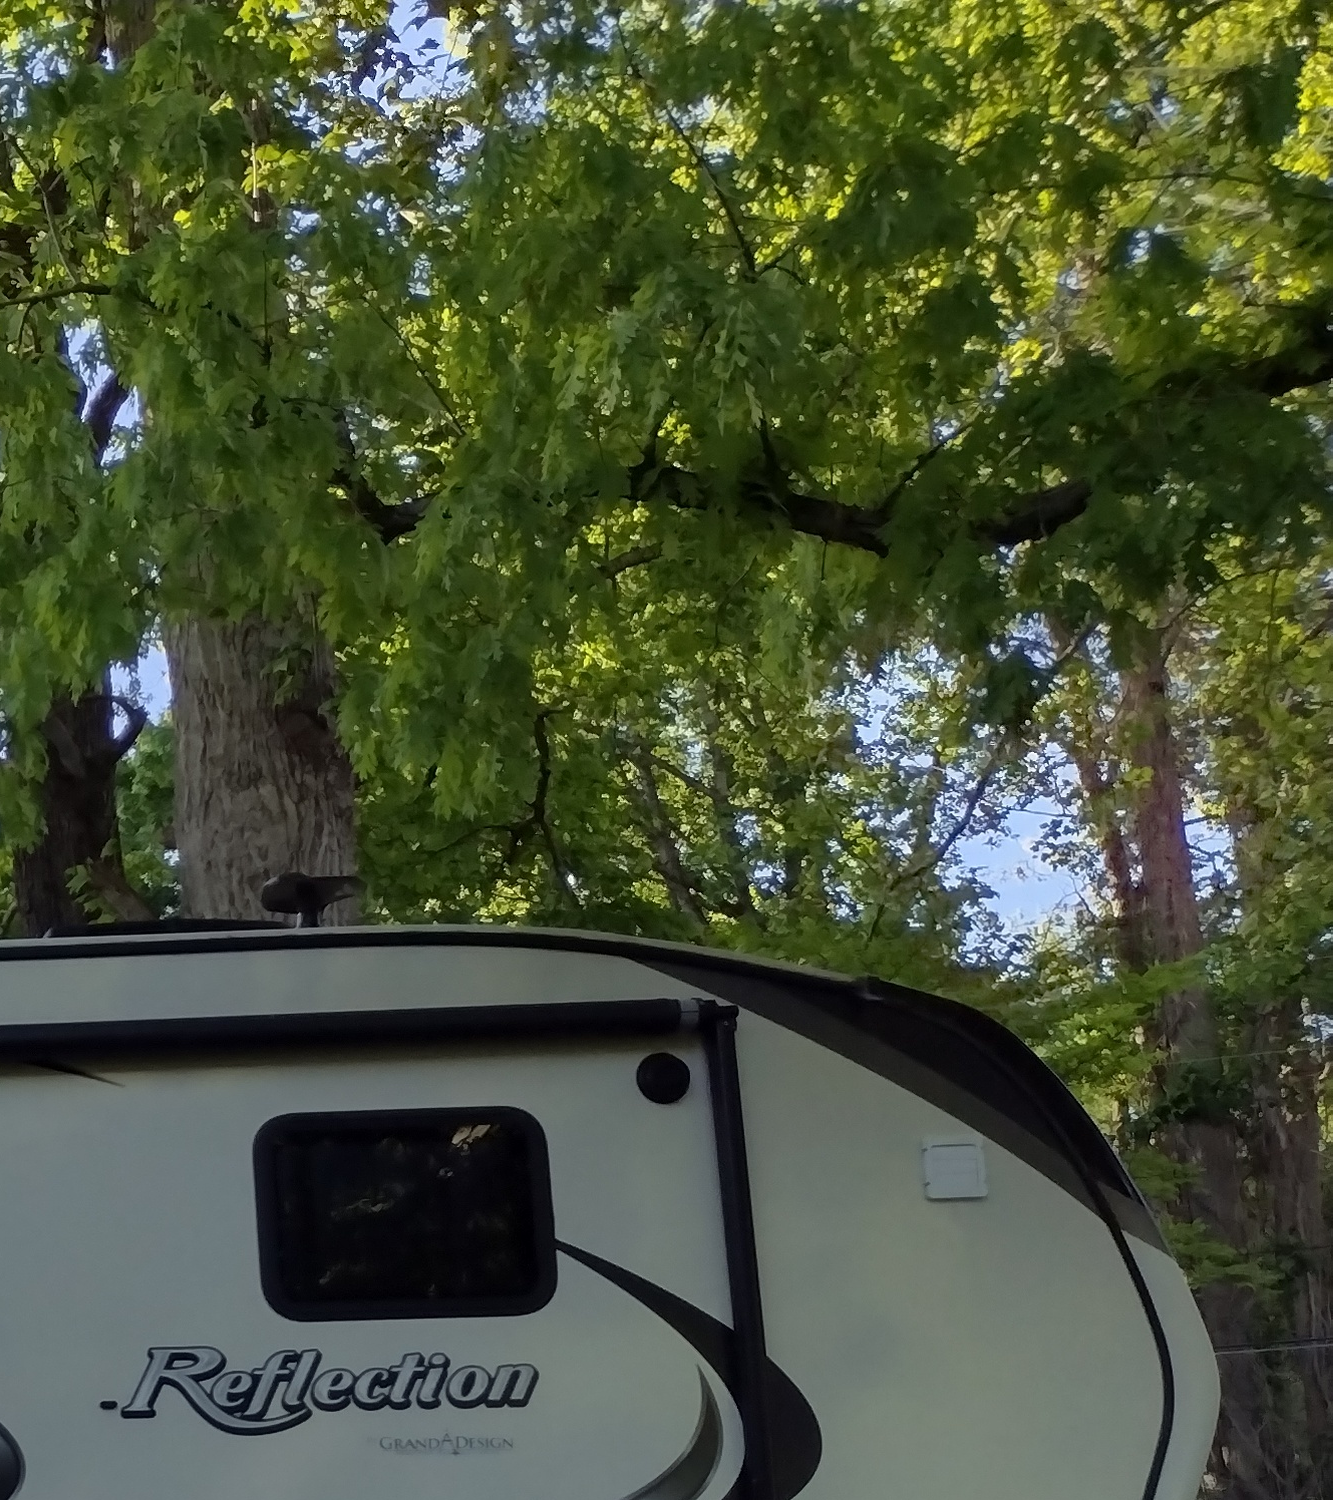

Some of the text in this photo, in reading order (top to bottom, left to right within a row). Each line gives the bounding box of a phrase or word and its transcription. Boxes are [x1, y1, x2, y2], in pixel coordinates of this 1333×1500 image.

[121, 1345, 539, 1436] Reflection
[379, 1436, 440, 1450] GRAND
[455, 1435, 514, 1450] DESIGN
